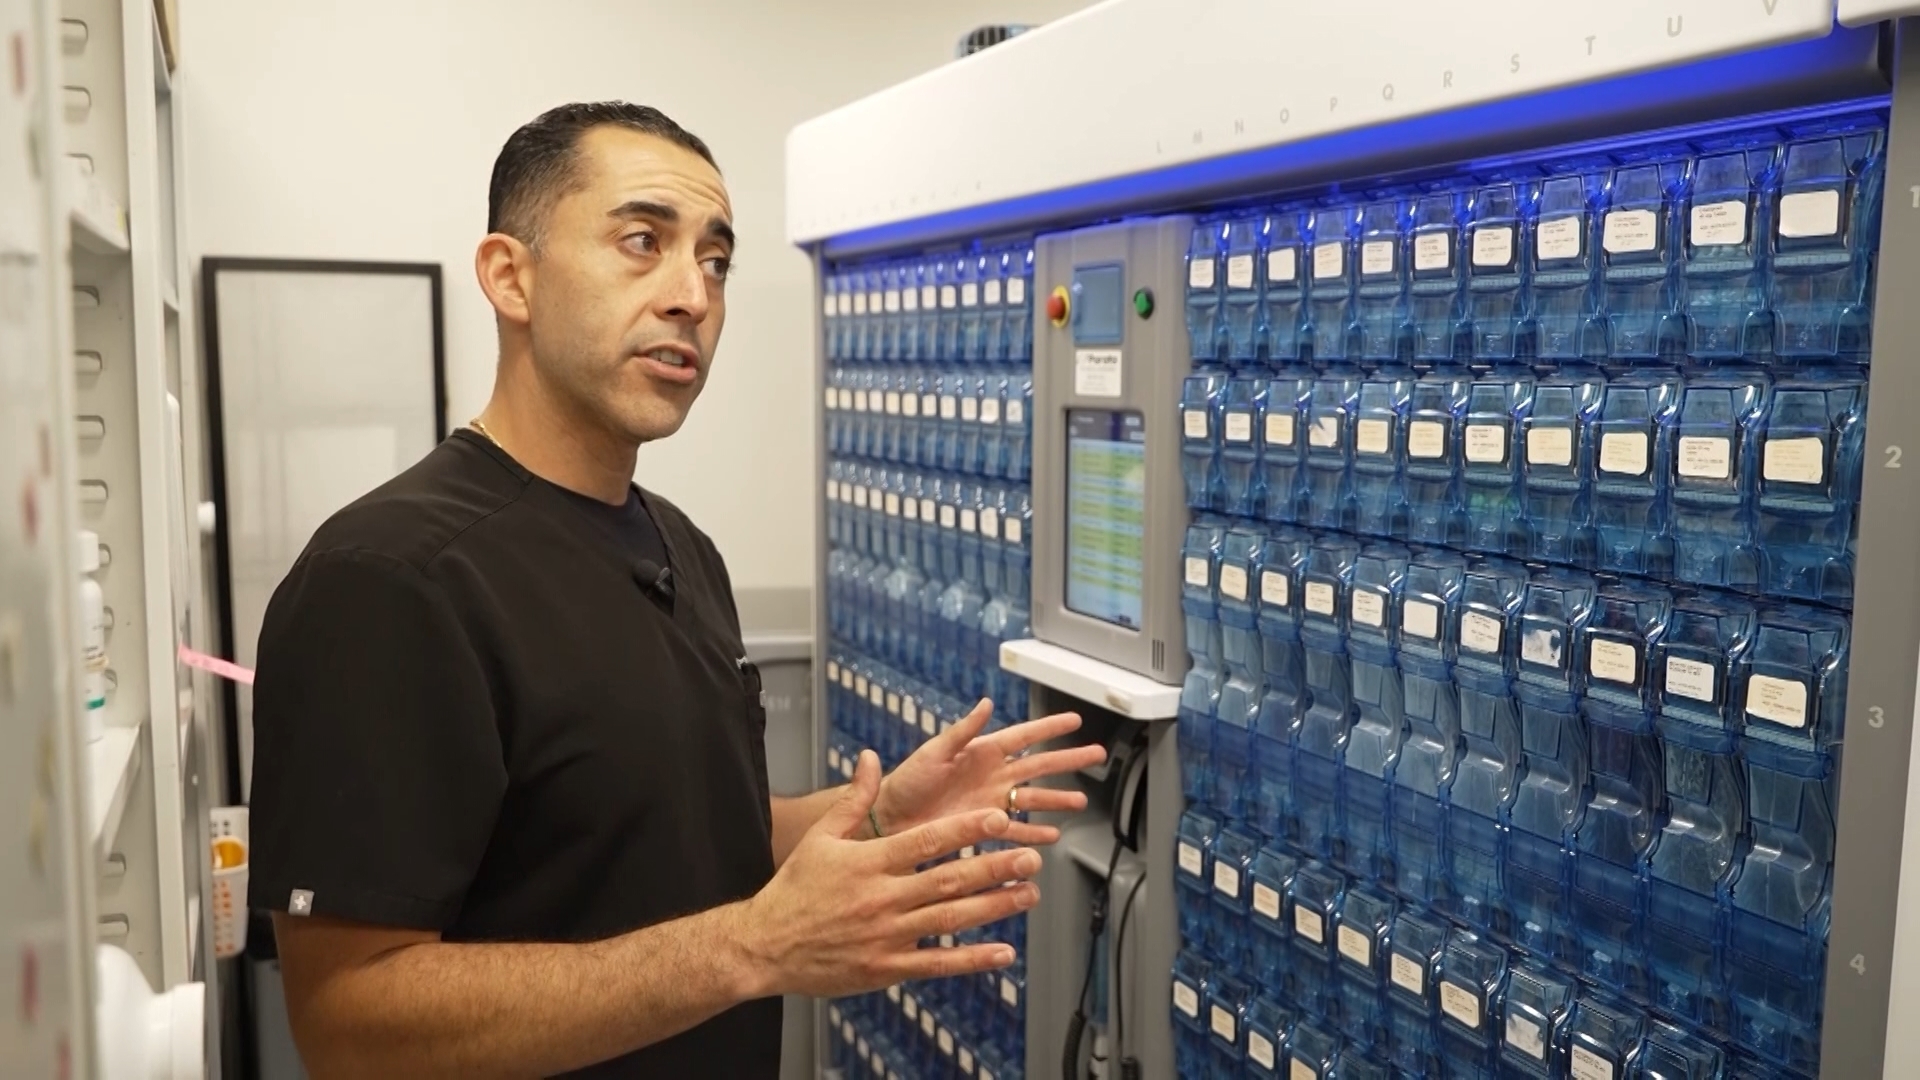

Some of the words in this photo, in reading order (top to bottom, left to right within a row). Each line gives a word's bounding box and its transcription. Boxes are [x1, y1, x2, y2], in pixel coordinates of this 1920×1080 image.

[1234, 120, 1245, 134] N
[1279, 108, 1290, 124] O
[1329, 96, 1338, 112] P
[1382, 83, 1395, 102] Q
[1442, 71, 1454, 88] R
[1510, 54, 1521, 74] S
[1584, 35, 1597, 56] T
[1666, 15, 1683, 38] U
[1762, 0, 1779, 17] V
[1910, 185, 1920, 208] 1
[1885, 445, 1903, 469] 2
[1868, 706, 1884, 728] 3
[1849, 953, 1866, 976] 4
